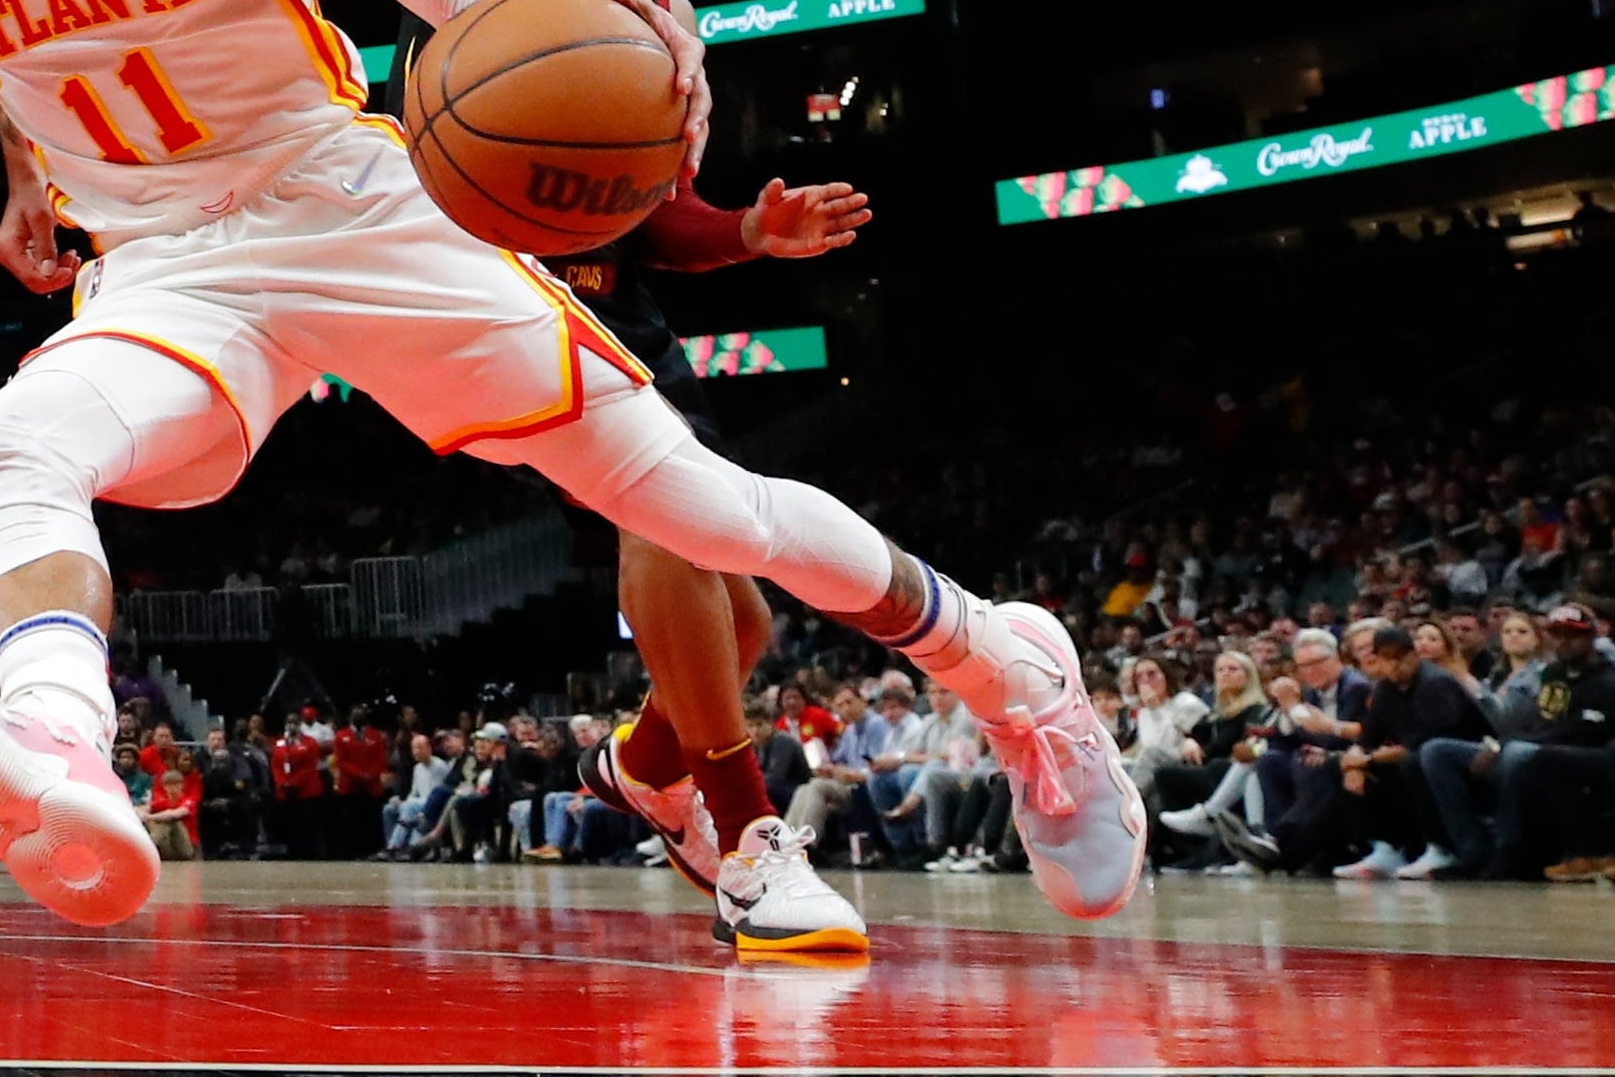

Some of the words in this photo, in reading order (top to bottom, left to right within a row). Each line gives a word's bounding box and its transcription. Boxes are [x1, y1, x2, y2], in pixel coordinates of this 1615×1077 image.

[60, 46, 213, 165] 11
[1409, 117, 1488, 150] APPLE
[566, 264, 603, 291] CAVS
